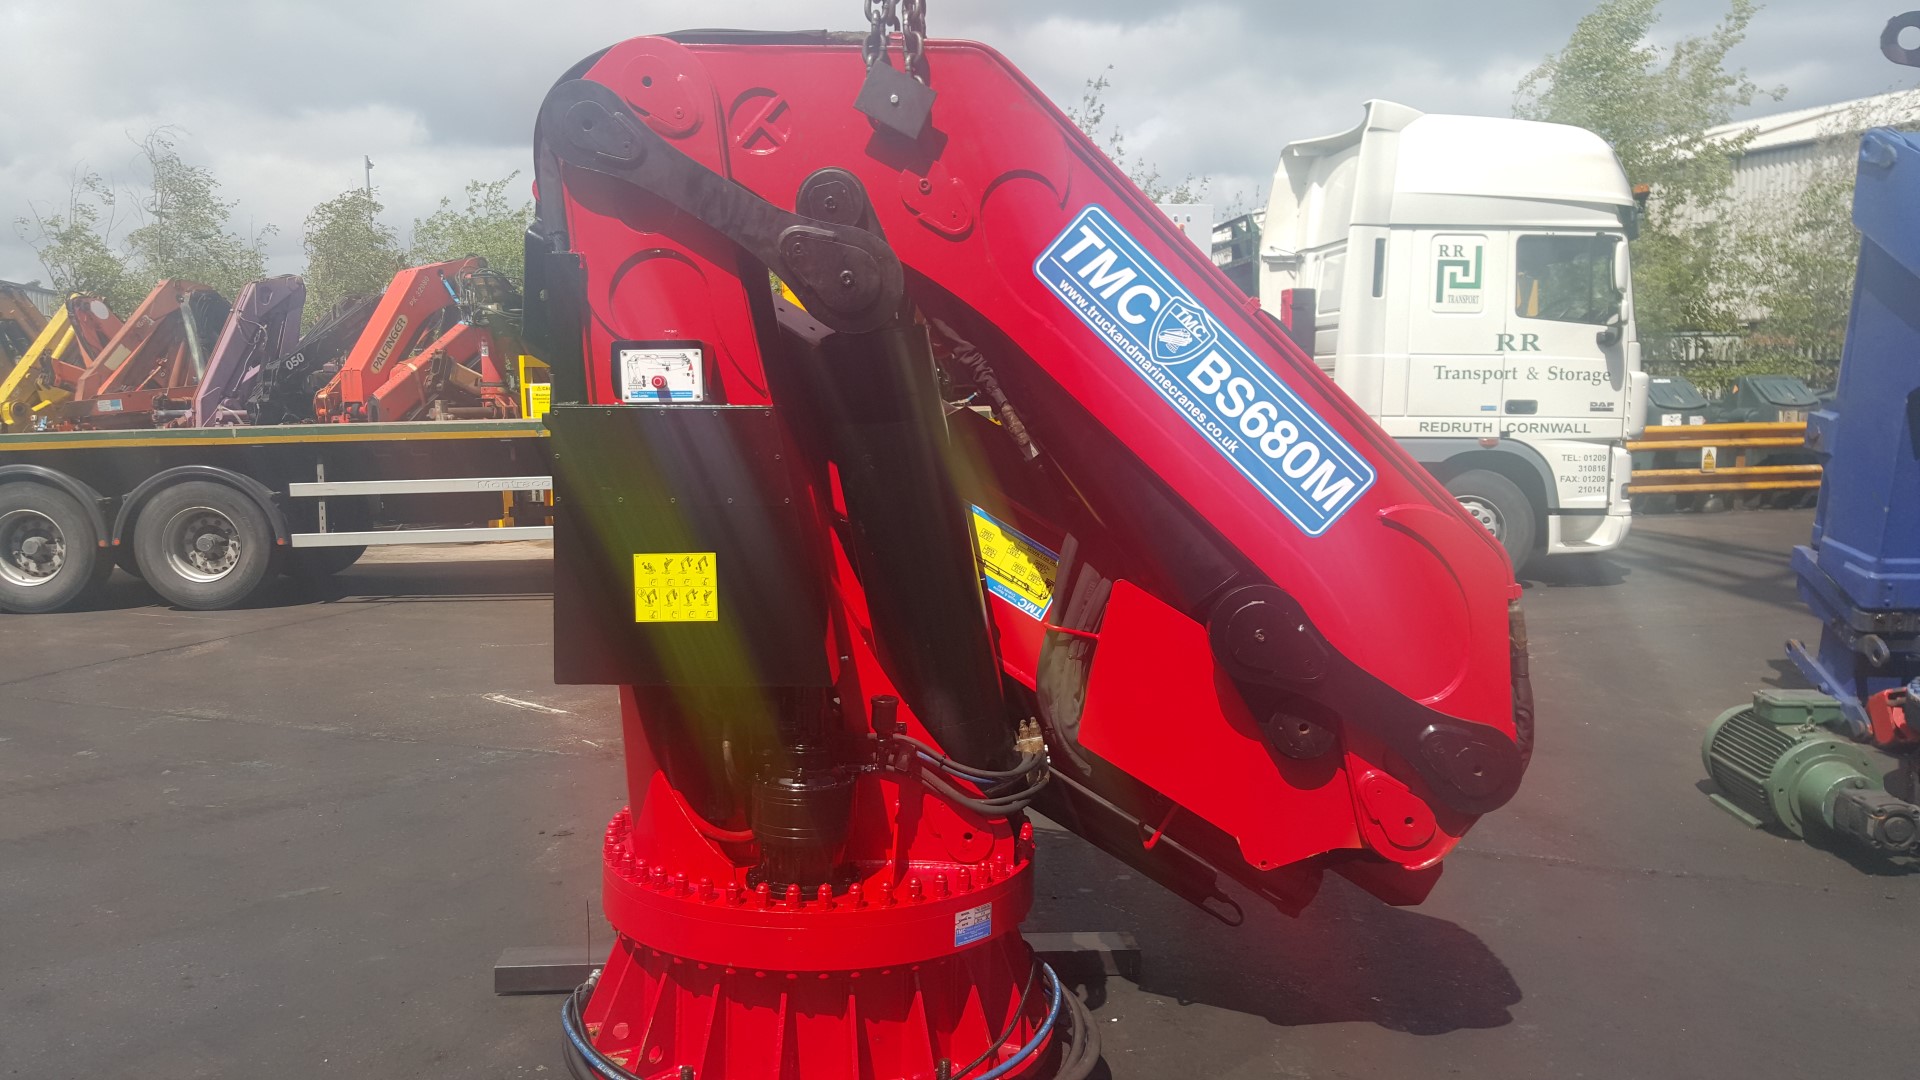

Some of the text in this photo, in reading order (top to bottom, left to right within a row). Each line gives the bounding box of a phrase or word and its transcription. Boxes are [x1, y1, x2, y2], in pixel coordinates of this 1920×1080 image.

[1438, 244, 1465, 258] RR
[1060, 224, 1161, 325] TMC
[1447, 294, 1480, 304] TRANSPORT
[1175, 308, 1207, 339] TMC
[372, 317, 406, 371] PALFINGER
[1495, 333, 1541, 351] RR
[285, 352, 305, 370] 050
[1059, 278, 1240, 454] www.truckandmarinecranes.co.uk
[1433, 365, 1611, 386] Transport & Storage
[1186, 350, 1356, 512] BS680M
[1419, 421, 1591, 434] REDRUTH CORNWALL
[1562, 454, 1607, 462] TEL: 01209
[1578, 464, 1606, 472] 310816
[1560, 475, 1606, 483] FAX: 01209
[1578, 486, 1606, 494] 210141
[1018, 598, 1043, 618] TMC
